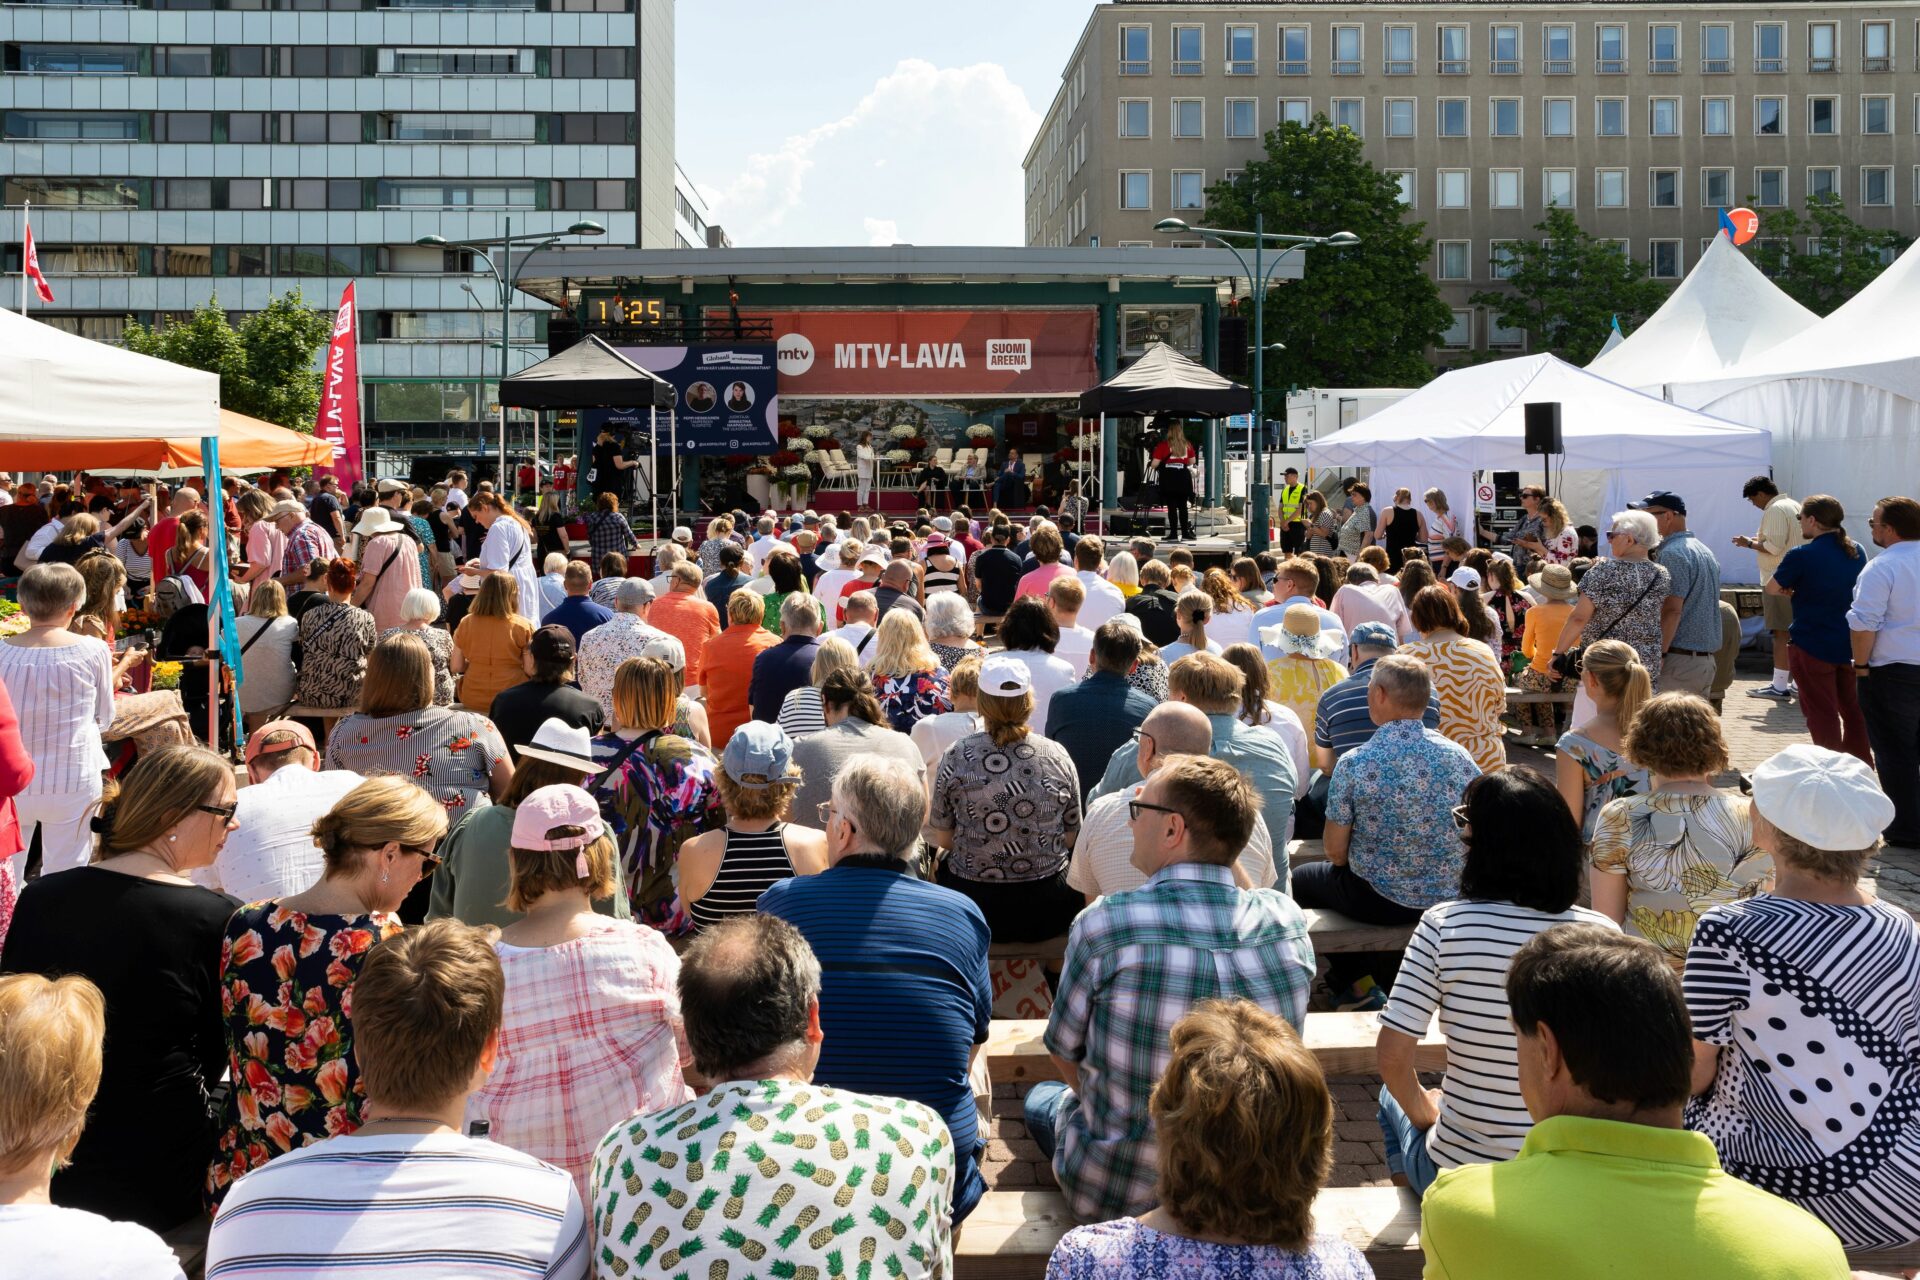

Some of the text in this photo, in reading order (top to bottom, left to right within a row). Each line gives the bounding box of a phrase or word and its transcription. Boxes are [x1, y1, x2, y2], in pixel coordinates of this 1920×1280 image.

[778, 347, 809, 360] mtv
[991, 343, 1026, 354] SUOMI
[834, 343, 966, 369] MTV-LAVA
[990, 354, 1027, 366] AREENA
